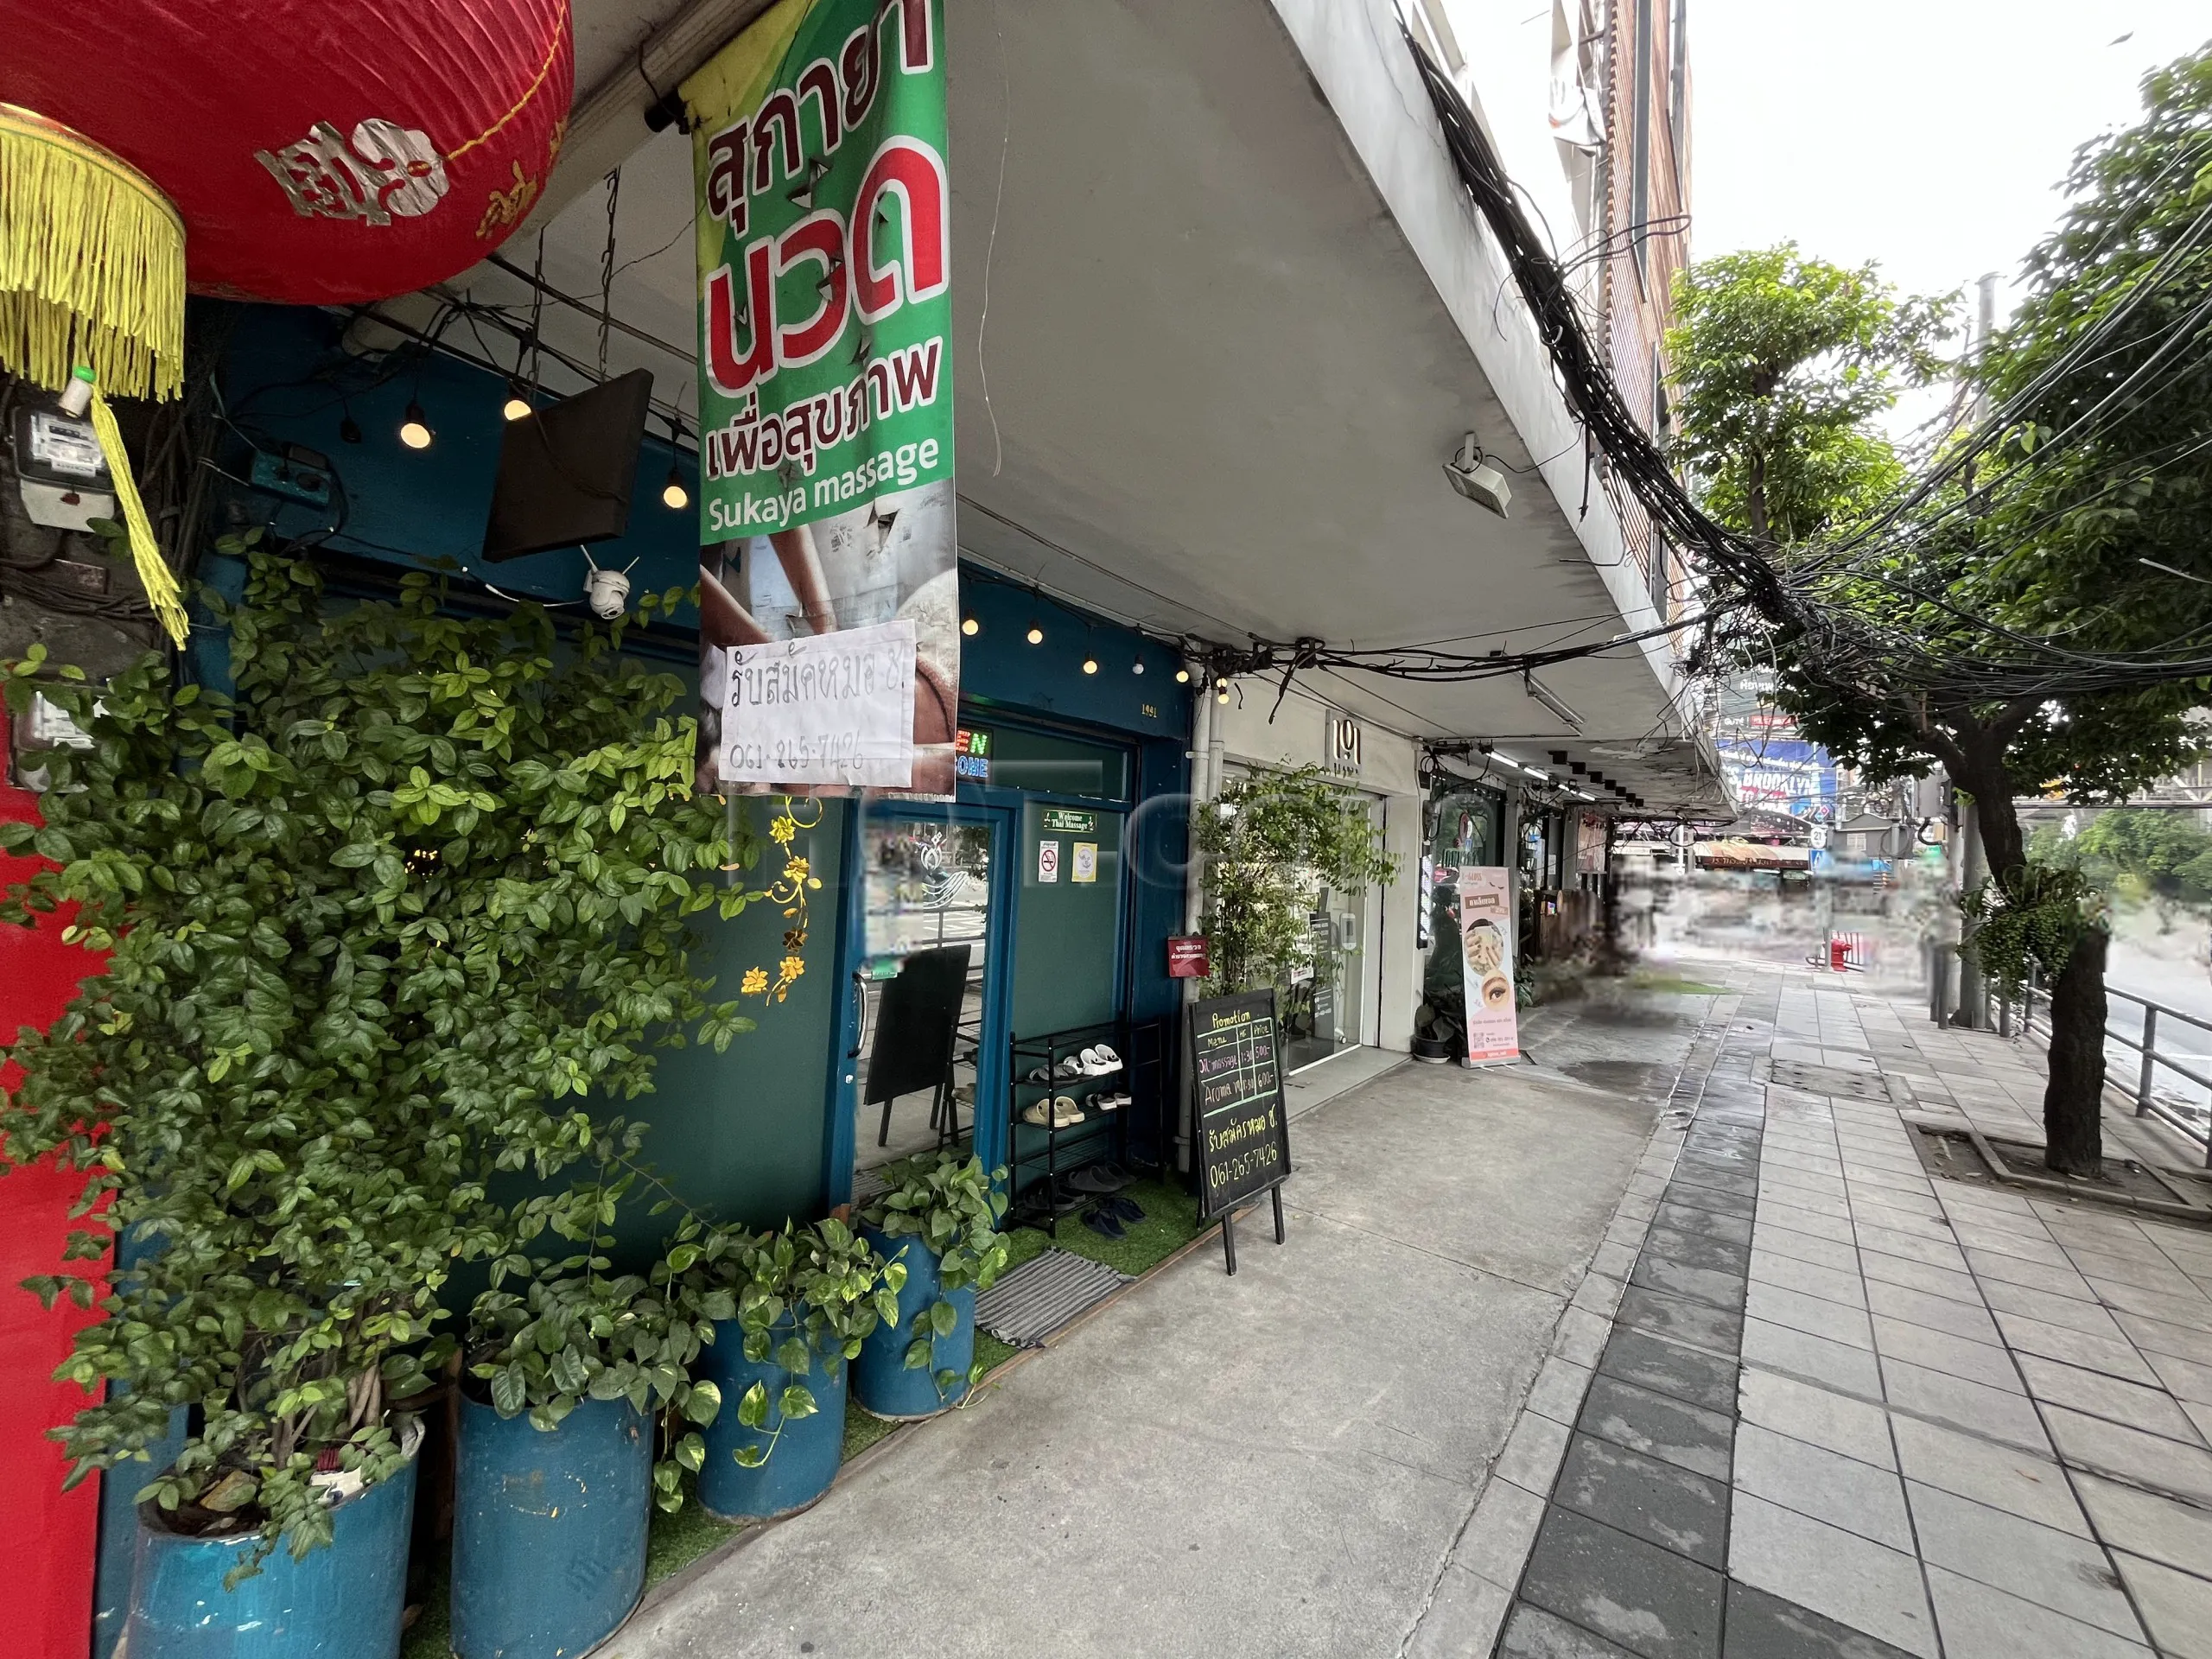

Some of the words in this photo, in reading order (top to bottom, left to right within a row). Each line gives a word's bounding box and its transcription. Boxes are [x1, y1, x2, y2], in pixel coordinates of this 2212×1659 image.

[704, 136, 950, 398] นวด
[705, 335, 944, 480] เพื่อสุขภาพ
[709, 481, 807, 532] Sukaya
[814, 438, 939, 505] massage
[1052, 818, 1065, 828] Thai
[1065, 820, 1088, 831] Massage
[1058, 811, 1083, 822] Welcome
[1212, 1009, 1250, 1029] Promotion
[1210, 1141, 1277, 1188] 061-265-7426
